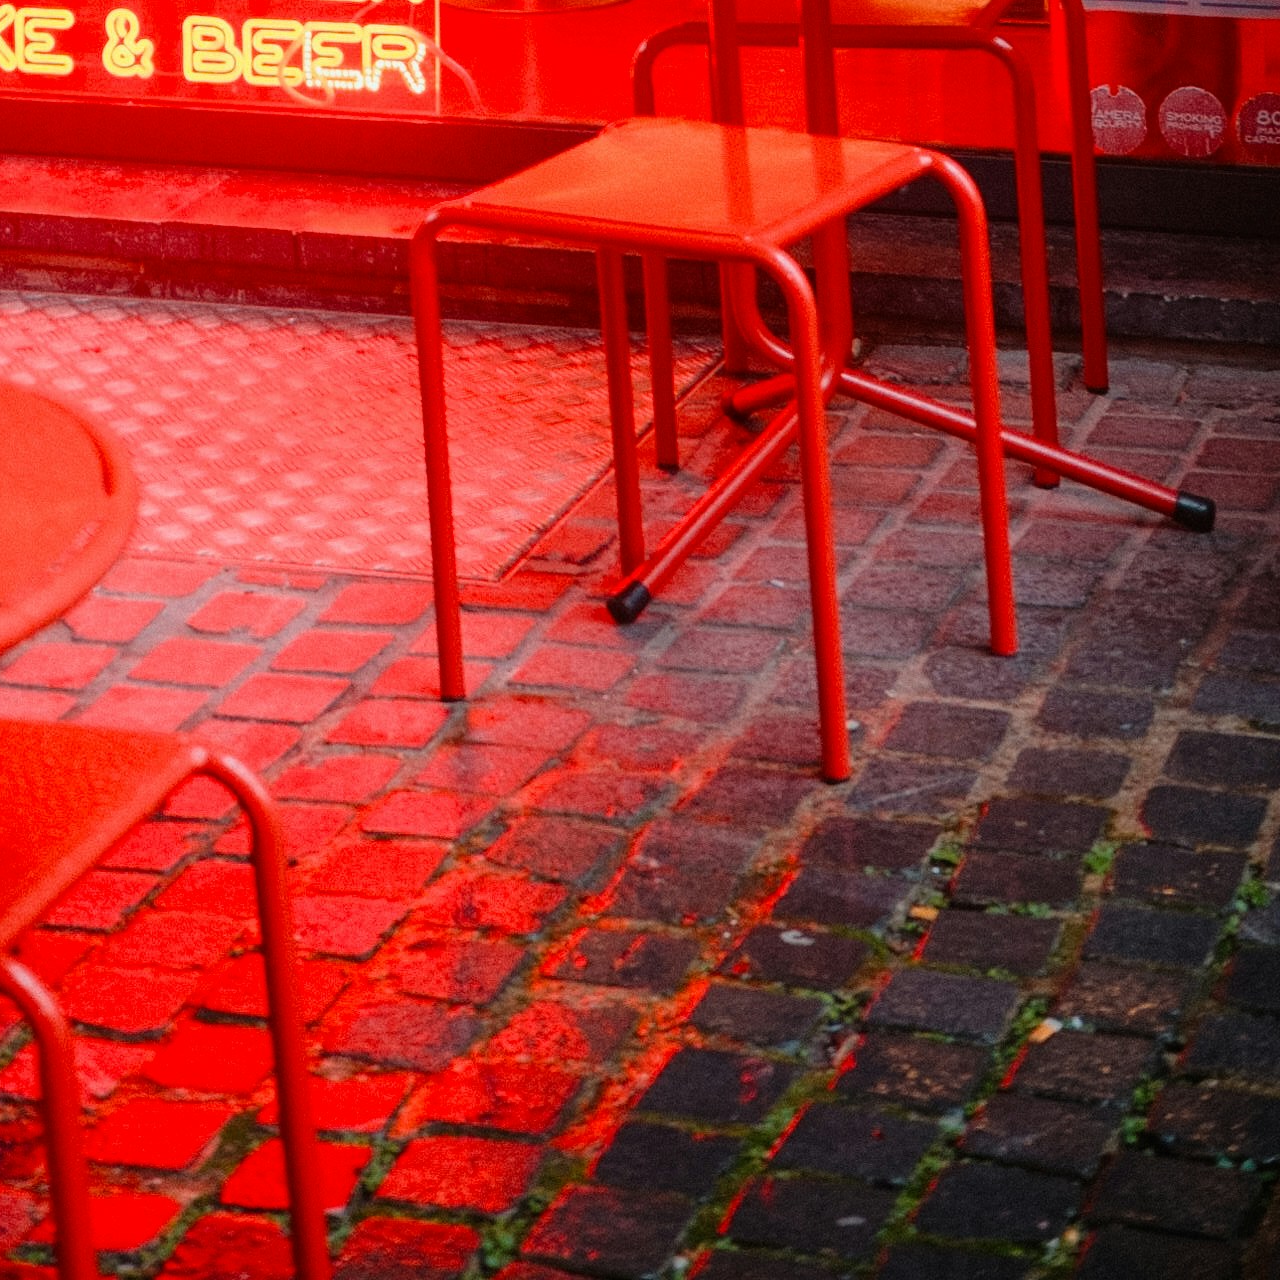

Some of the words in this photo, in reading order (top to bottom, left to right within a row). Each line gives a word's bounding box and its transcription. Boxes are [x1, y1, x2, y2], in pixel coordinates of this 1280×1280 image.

[102, 7, 152, 77] &
[182, 15, 426, 94] BEER
[1095, 109, 1141, 120] AMERA
[1166, 112, 1222, 125] SMOKING
